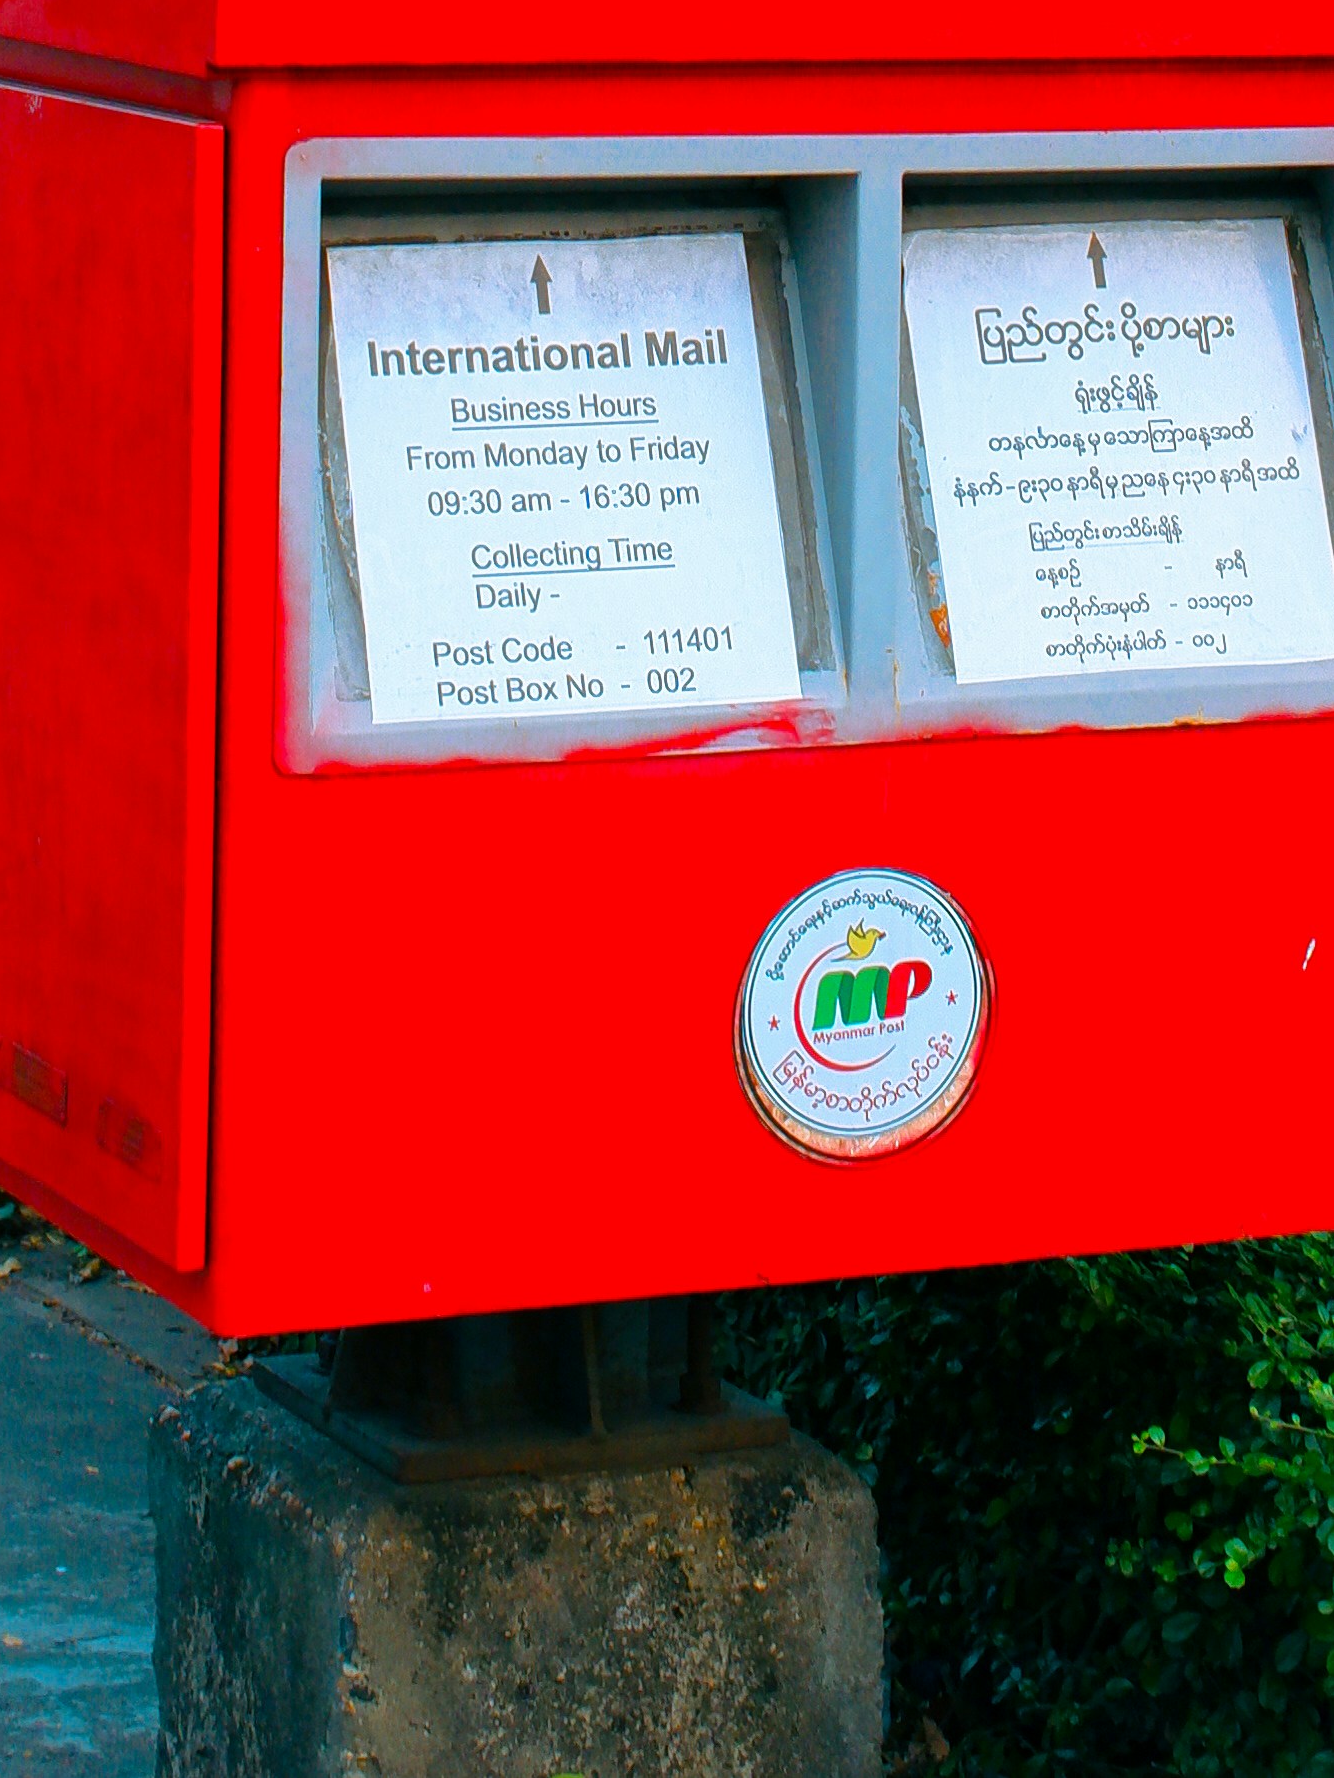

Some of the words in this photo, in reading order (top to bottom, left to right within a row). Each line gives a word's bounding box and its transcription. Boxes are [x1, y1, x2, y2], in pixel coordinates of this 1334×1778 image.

[367, 330, 631, 377] International
[645, 329, 727, 367] Mail
[451, 396, 570, 423] Business
[579, 393, 656, 418] Hours
[407, 446, 475, 471] From
[484, 440, 588, 470] Monday
[596, 439, 621, 463] to
[630, 435, 709, 465] Friday
[428, 489, 501, 516] 09:30
[512, 493, 551, 512] am
[580, 482, 650, 509] 16:30
[660, 486, 699, 512] pm
[472, 541, 601, 573] Collecting
[607, 538, 672, 563] Time
[476, 582, 541, 613] Daily
[433, 640, 495, 667] Post
[502, 635, 572, 663] Code
[644, 626, 732, 655] 111401
[437, 680, 498, 707] Post
[506, 678, 558, 702] Box
[566, 673, 603, 699] No
[647, 667, 696, 694] 002
[813, 1025, 876, 1045] Myanmar
[879, 1021, 905, 1036] Post
